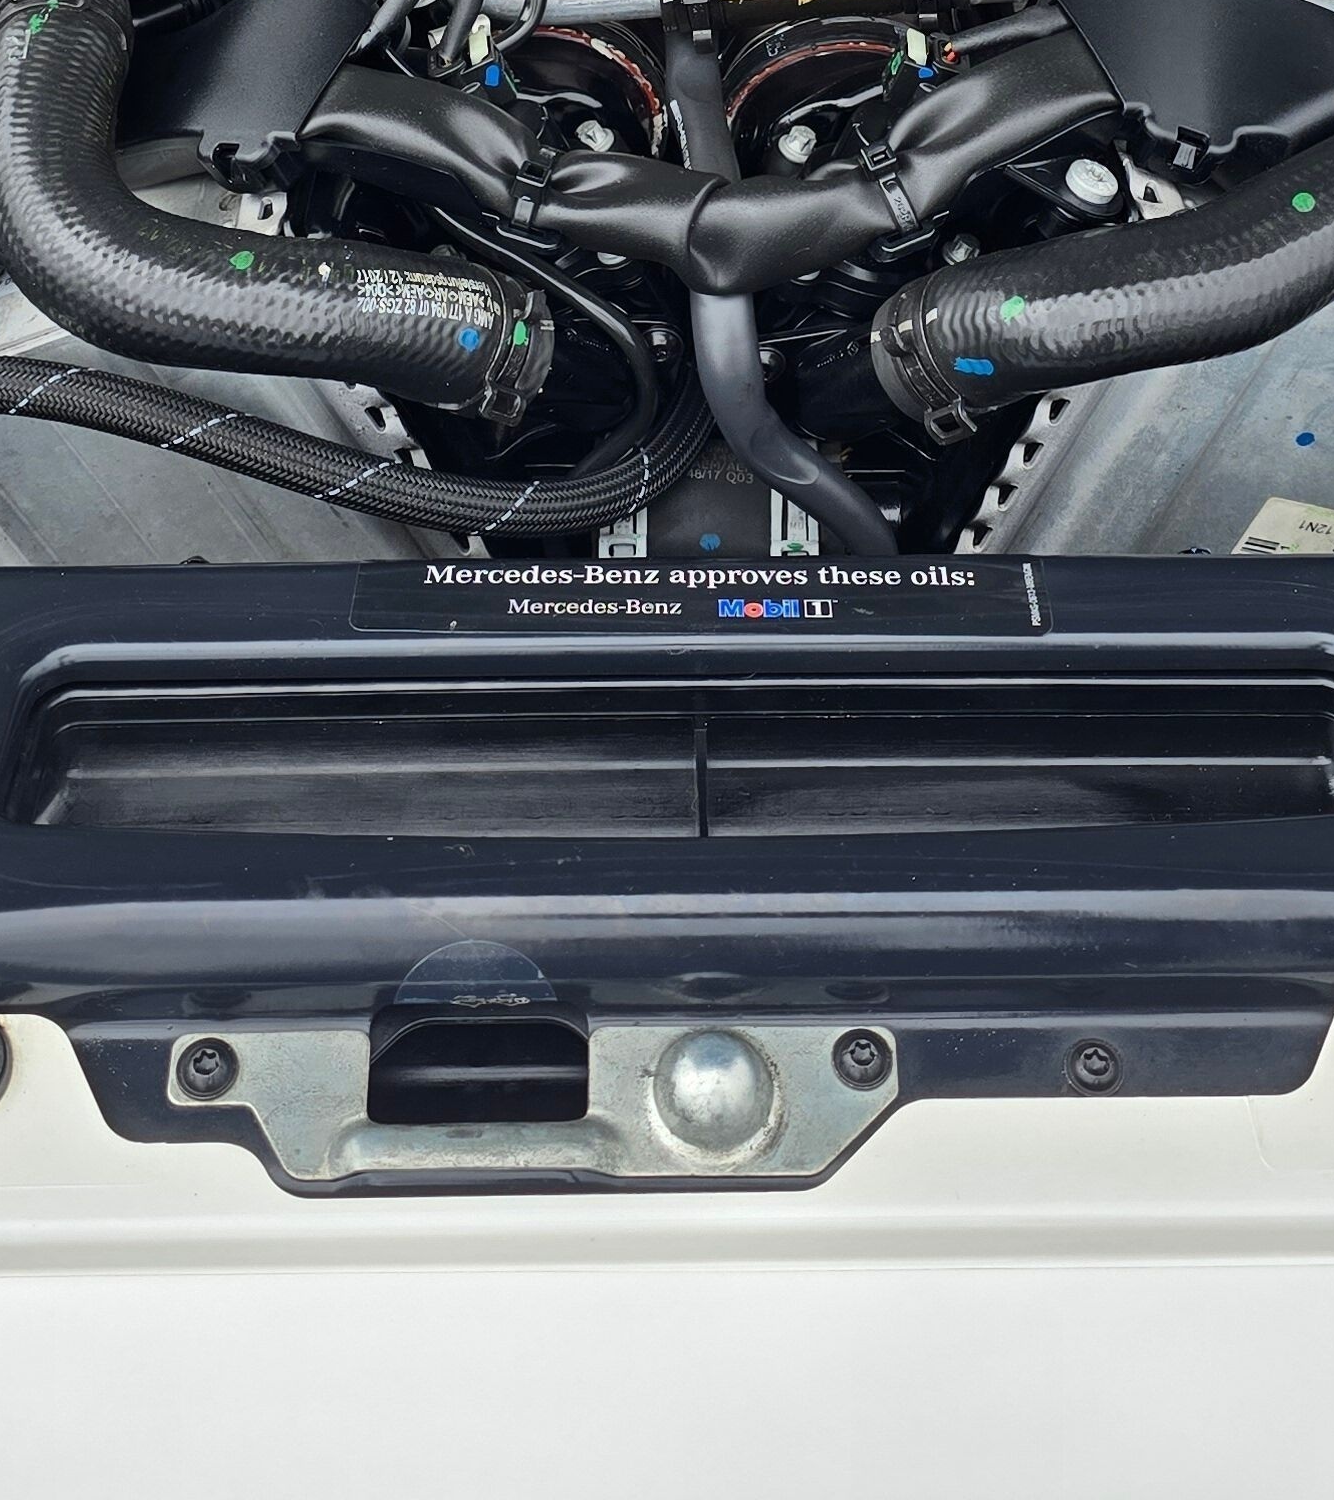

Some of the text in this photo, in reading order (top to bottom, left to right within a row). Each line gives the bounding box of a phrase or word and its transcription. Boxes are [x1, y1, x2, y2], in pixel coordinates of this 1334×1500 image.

[404, 299, 417, 315] 82
[418, 300, 430, 316] 07
[431, 301, 447, 319] 094
[449, 303, 463, 321] 177
[464, 306, 473, 323] A
[473, 308, 495, 330] AMG
[725, 470, 755, 485] Q03
[1299, 520, 1334, 536] 12N1
[425, 563, 976, 590] Mercedes-Benz approves these oils:
[507, 598, 832, 619] Mercedes-Benz Mobil 1
